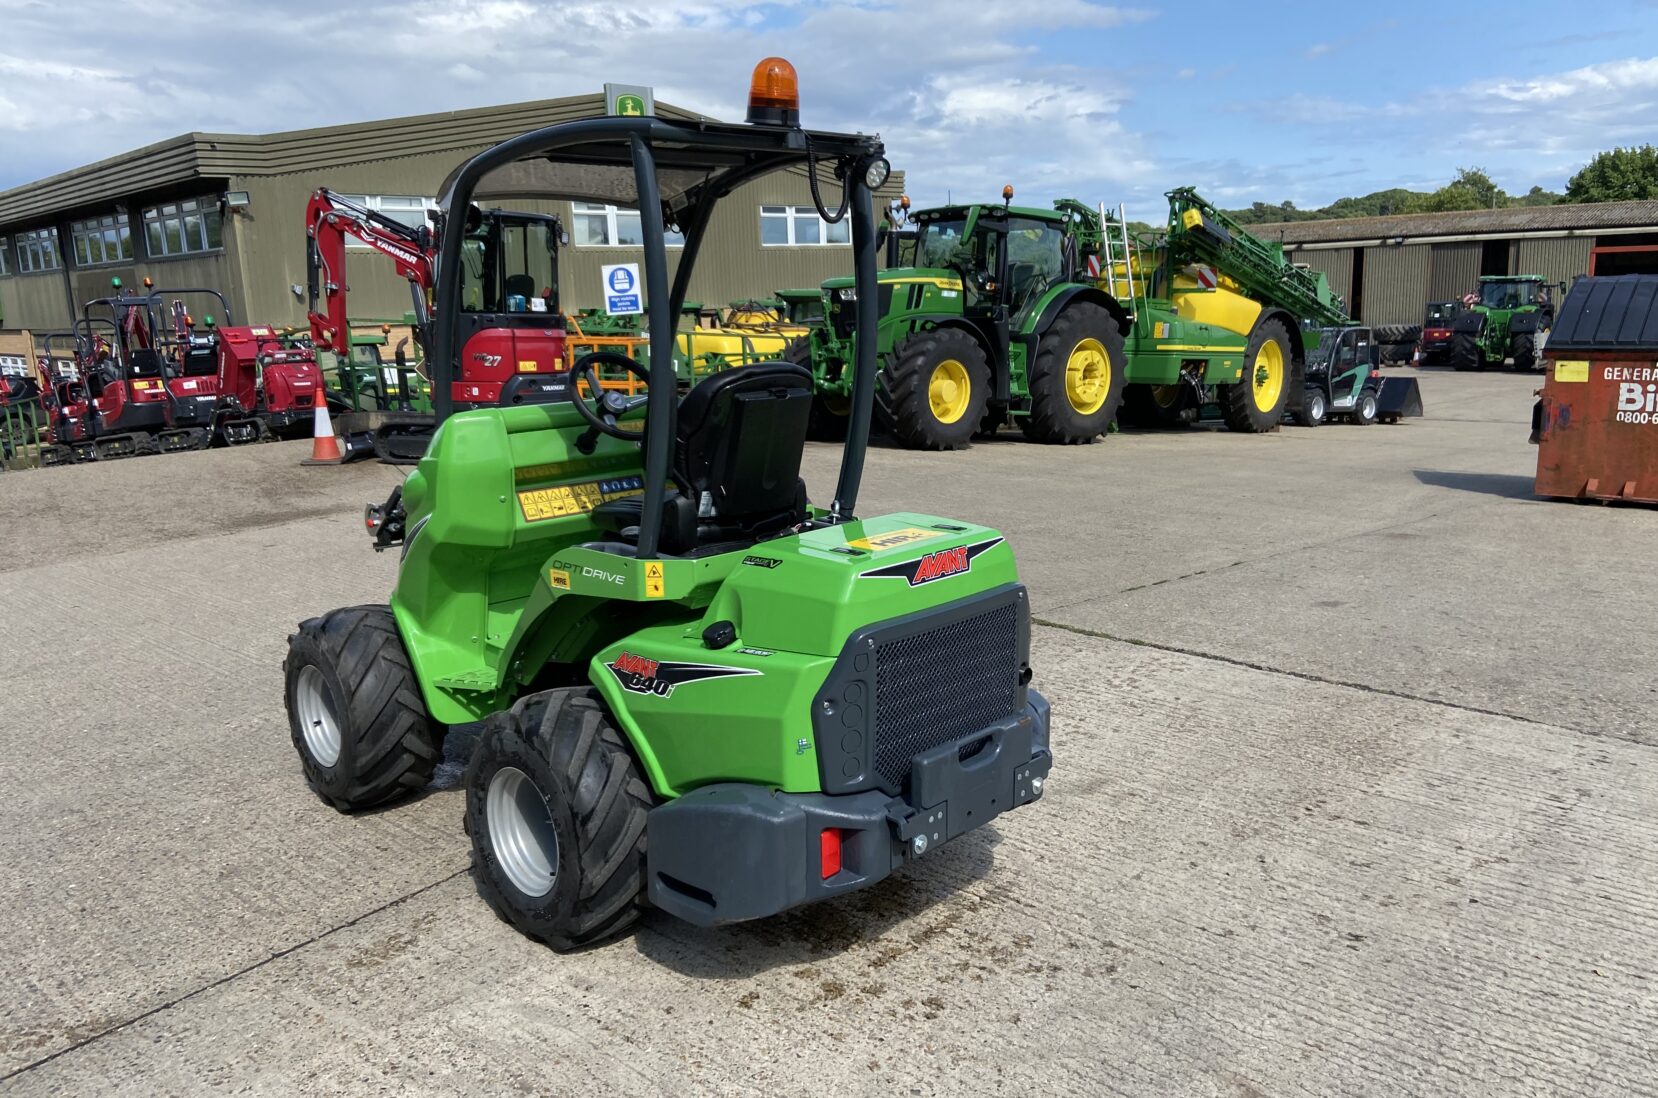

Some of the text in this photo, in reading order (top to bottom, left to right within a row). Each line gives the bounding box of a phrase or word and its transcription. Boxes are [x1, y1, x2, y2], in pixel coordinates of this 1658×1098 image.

[376, 239, 418, 264] YANMAR
[1617, 382, 1658, 412] Bi
[912, 545, 968, 584] AVANT
[611, 651, 659, 680] AVANT
[629, 672, 676, 699] 640i
